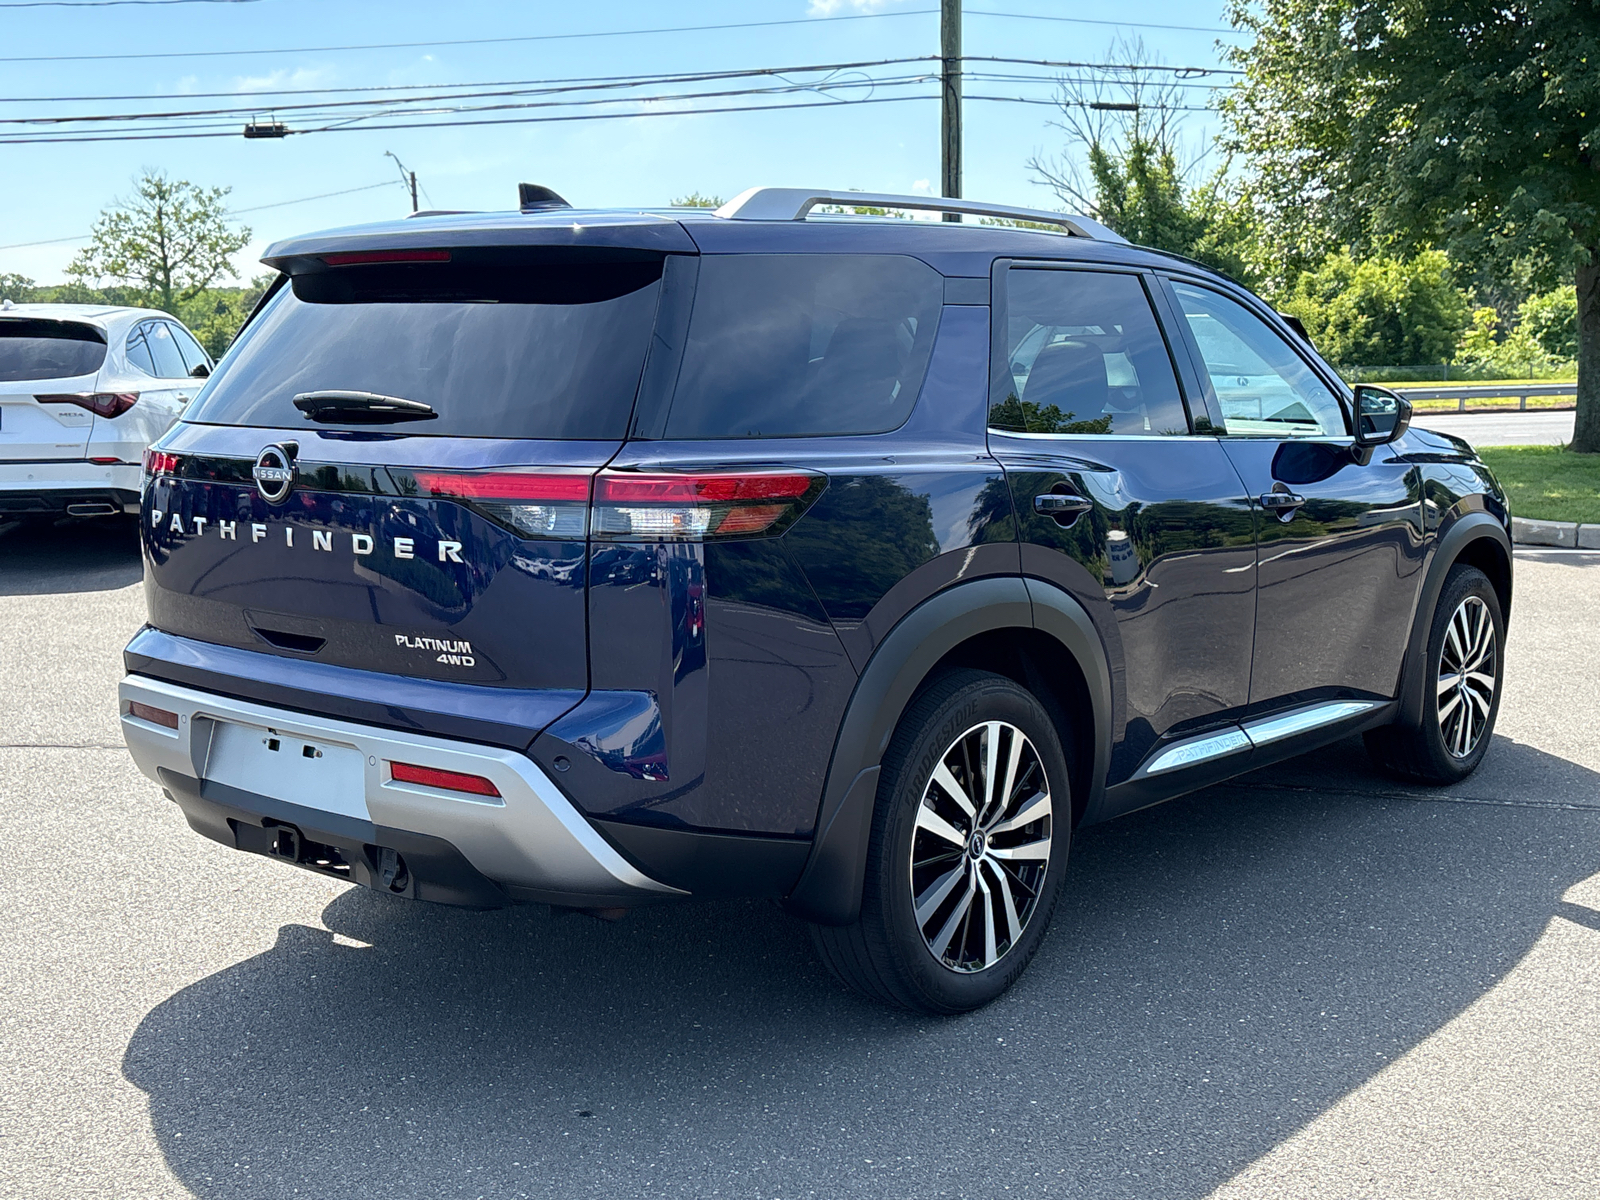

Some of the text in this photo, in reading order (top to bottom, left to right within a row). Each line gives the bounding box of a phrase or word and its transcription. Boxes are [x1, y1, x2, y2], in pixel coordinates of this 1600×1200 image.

[253, 469, 291, 480] NISSAN
[151, 509, 464, 563] PATHFINDER
[395, 634, 473, 654] PLATINUM
[436, 653, 476, 667] 4WD
[904, 698, 979, 812] BRIDGESTONE
[1176, 734, 1246, 761] PATHFINDER
